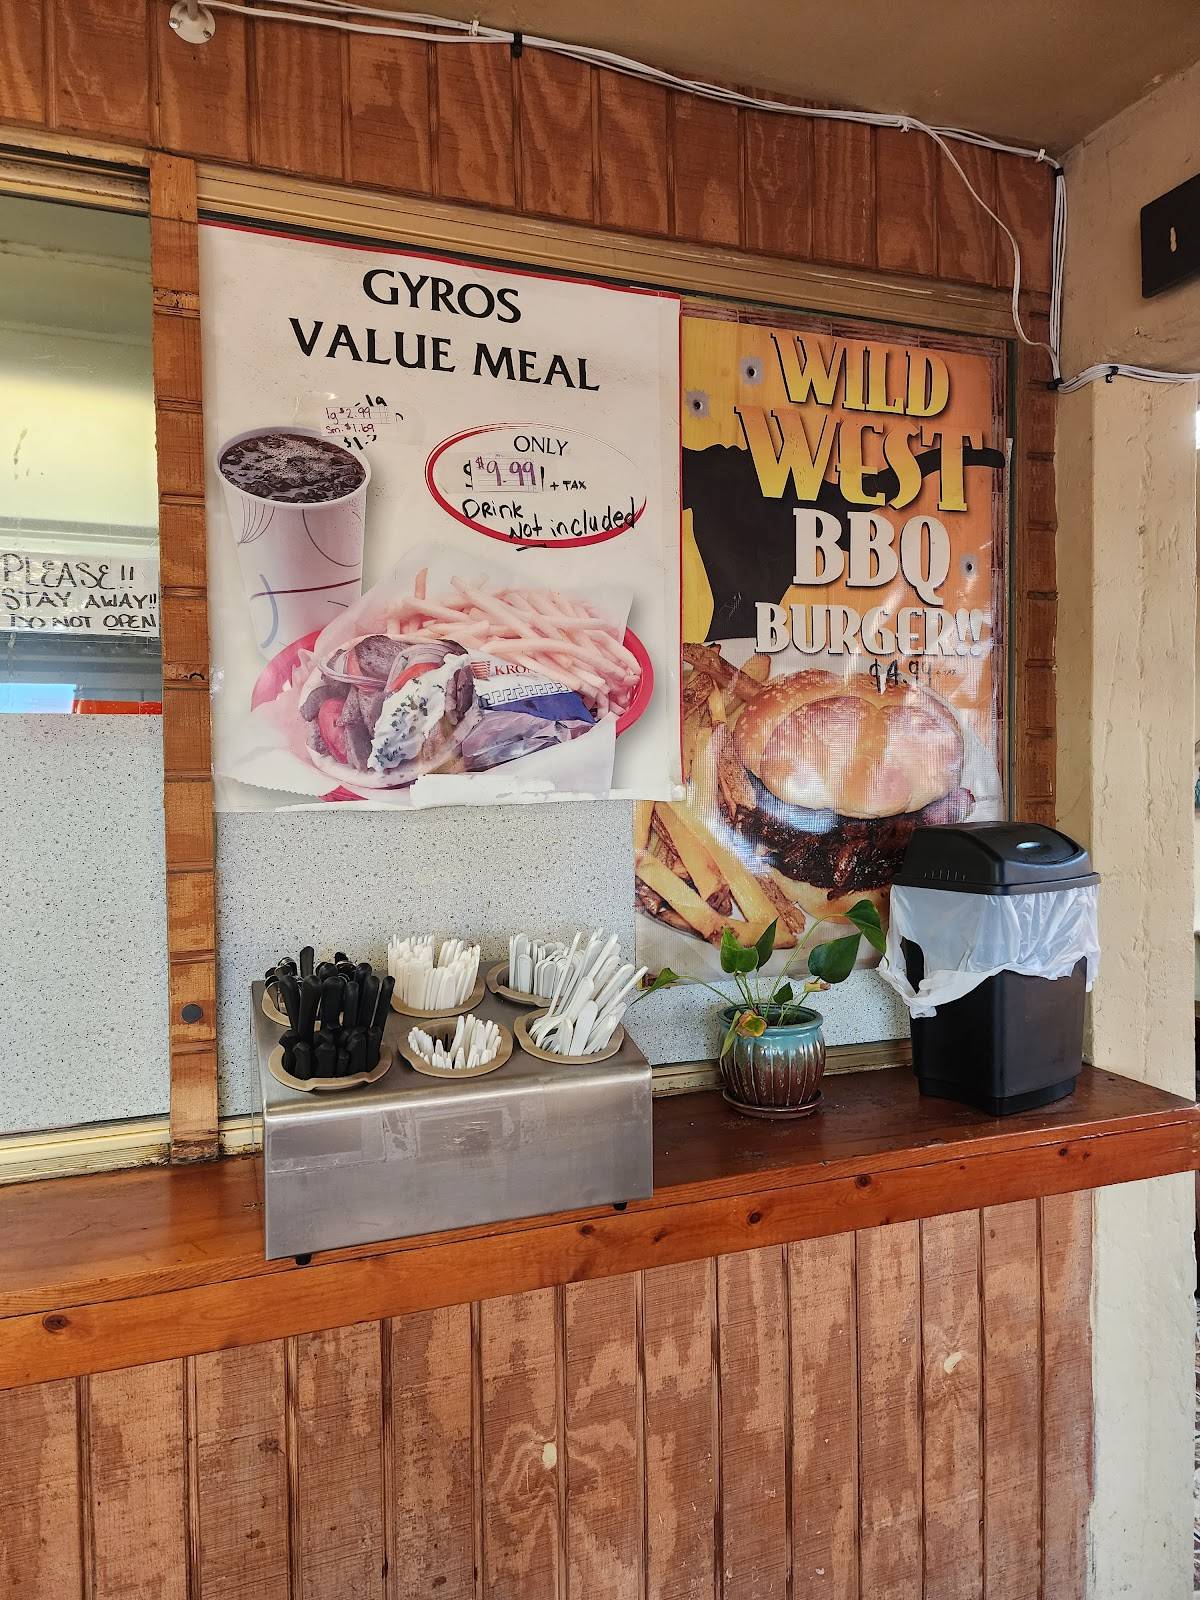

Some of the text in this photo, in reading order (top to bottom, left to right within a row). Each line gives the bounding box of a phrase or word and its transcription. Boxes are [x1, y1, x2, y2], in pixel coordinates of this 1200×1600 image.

[362, 268, 522, 324] GYROS
[289, 317, 600, 391] VALUE MEAL
[770, 333, 951, 418] WILD
[513, 435, 569, 456] ONLY
[734, 405, 984, 513] WEST
[475, 456, 537, 487] $9.99
[562, 480, 588, 490] TAX
[550, 496, 636, 538] included
[792, 507, 952, 606] BBQ
[0, 588, 157, 610] STAY AWAY!!
[52, 615, 93, 629] NOT
[103, 613, 157, 629] OPEN
[754, 601, 986, 657] BURGER!!
